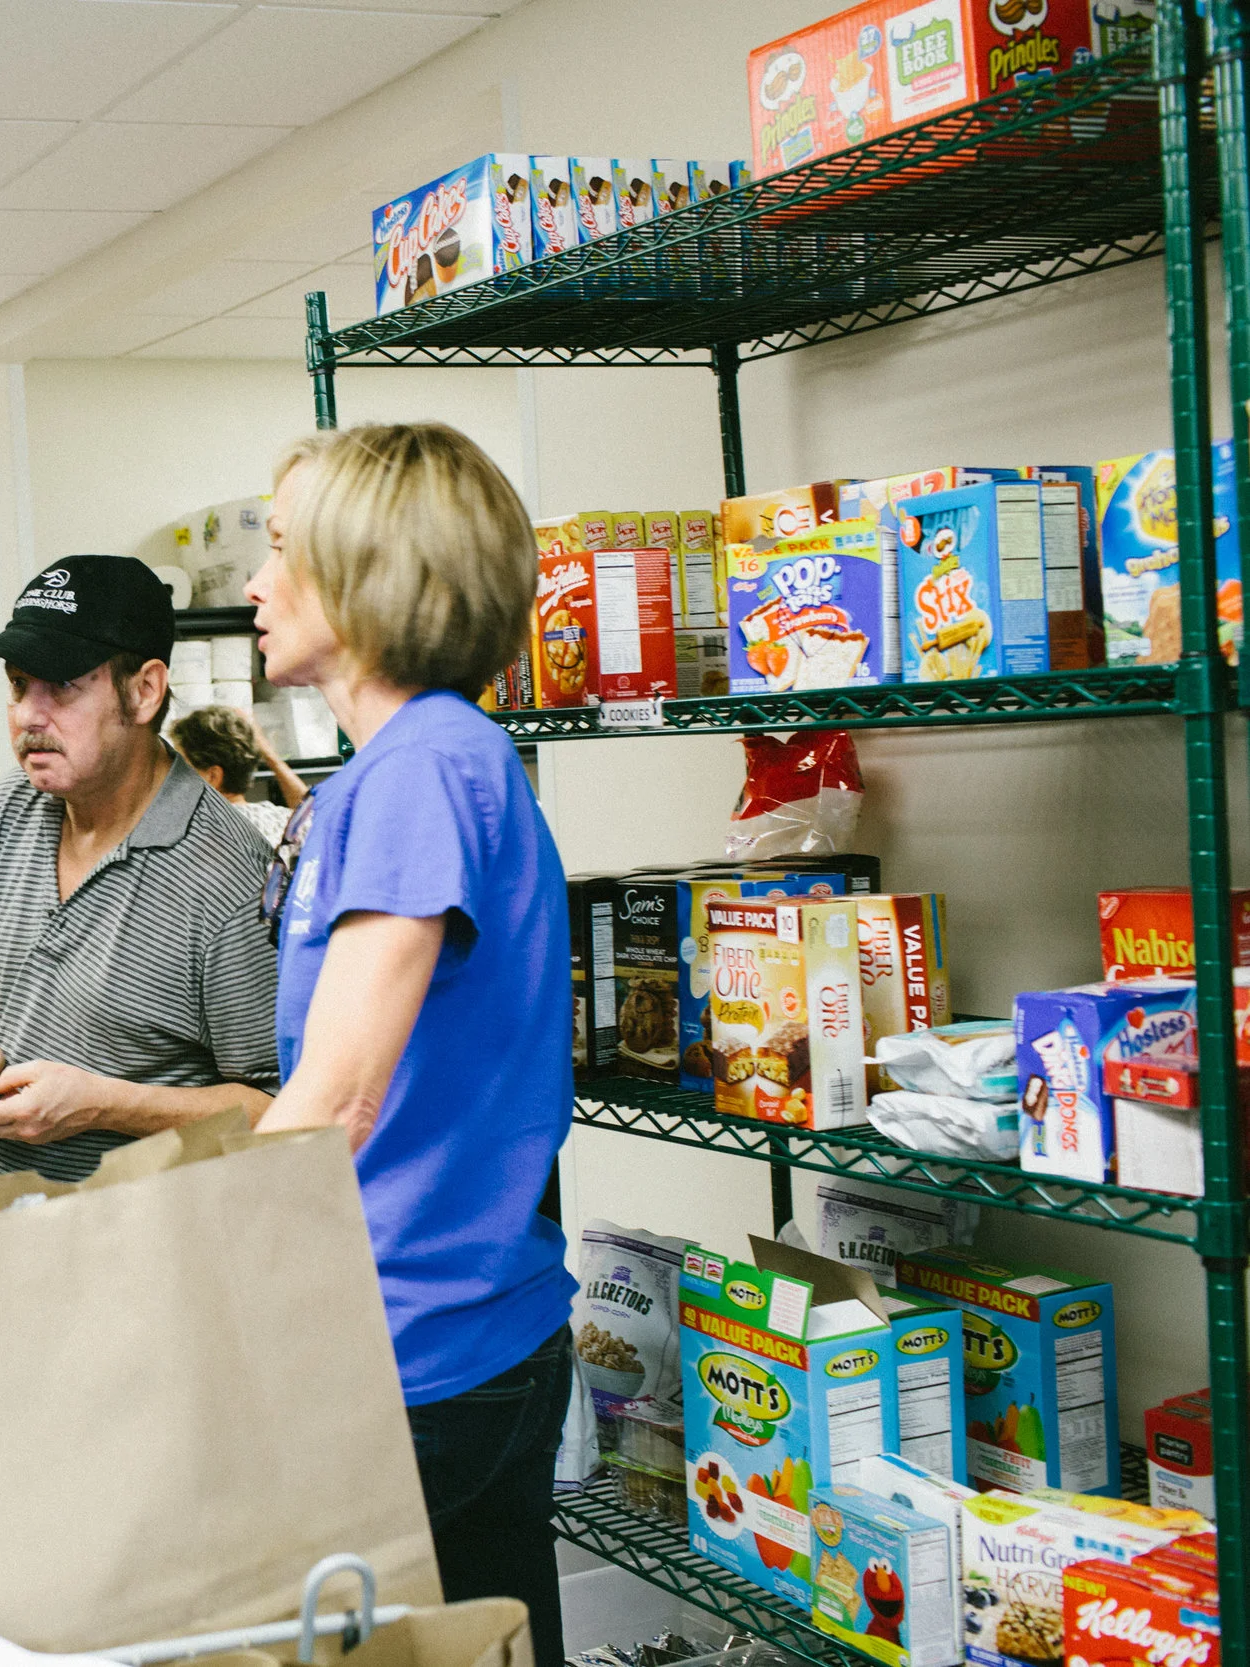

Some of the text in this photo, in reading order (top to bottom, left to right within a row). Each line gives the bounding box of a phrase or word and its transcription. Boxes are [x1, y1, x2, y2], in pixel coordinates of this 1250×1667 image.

[902, 29, 947, 60] FREE
[1074, 51, 1091, 65] 27
[903, 49, 949, 77] BOOK
[990, 30, 1060, 92] Pringles
[760, 94, 817, 168] Pringles
[495, 192, 513, 228] Cakes
[537, 197, 557, 232] Cakes
[578, 194, 598, 229] Cakes
[387, 177, 467, 289] Cup Cakes
[500, 226, 522, 254] Cup
[787, 538, 831, 553] PACK
[737, 559, 759, 572] 16
[43, 588, 76, 601] CLUB
[918, 577, 974, 630] Stix
[778, 610, 838, 636] Strawberry
[857, 661, 870, 677] 16
[609, 707, 650, 722] COOKIES
[619, 889, 665, 920] Sam's
[710, 910, 776, 929] VALUE PACK
[631, 916, 661, 926] CHOICE
[782, 915, 794, 931] 10
[616, 952, 630, 960] DARK
[631, 953, 663, 962] CHOCOLATE
[625, 946, 666, 956] WHOLE WHEAT
[713, 943, 758, 970] FIBER
[857, 918, 876, 987] One
[872, 917, 894, 979] FIBER
[715, 966, 762, 1000] One
[903, 924, 929, 1034] VALUE PA
[718, 1002, 759, 1021] Protein
[820, 985, 840, 1039] One
[837, 983, 849, 1032] FIBER
[1117, 1014, 1187, 1058] Hostess
[918, 1269, 975, 1302] VALUE
[977, 1287, 1031, 1318] PACK
[699, 1311, 751, 1349] VALUE
[751, 1332, 804, 1368] PACK
[1016, 1524, 1057, 1545] Kellogg's
[978, 1534, 1079, 1570] Nutri Gra
[996, 1566, 1064, 1605] HARVE
[1063, 1574, 1107, 1598] NEW!
[1075, 1597, 1212, 1667] Kellogg's
